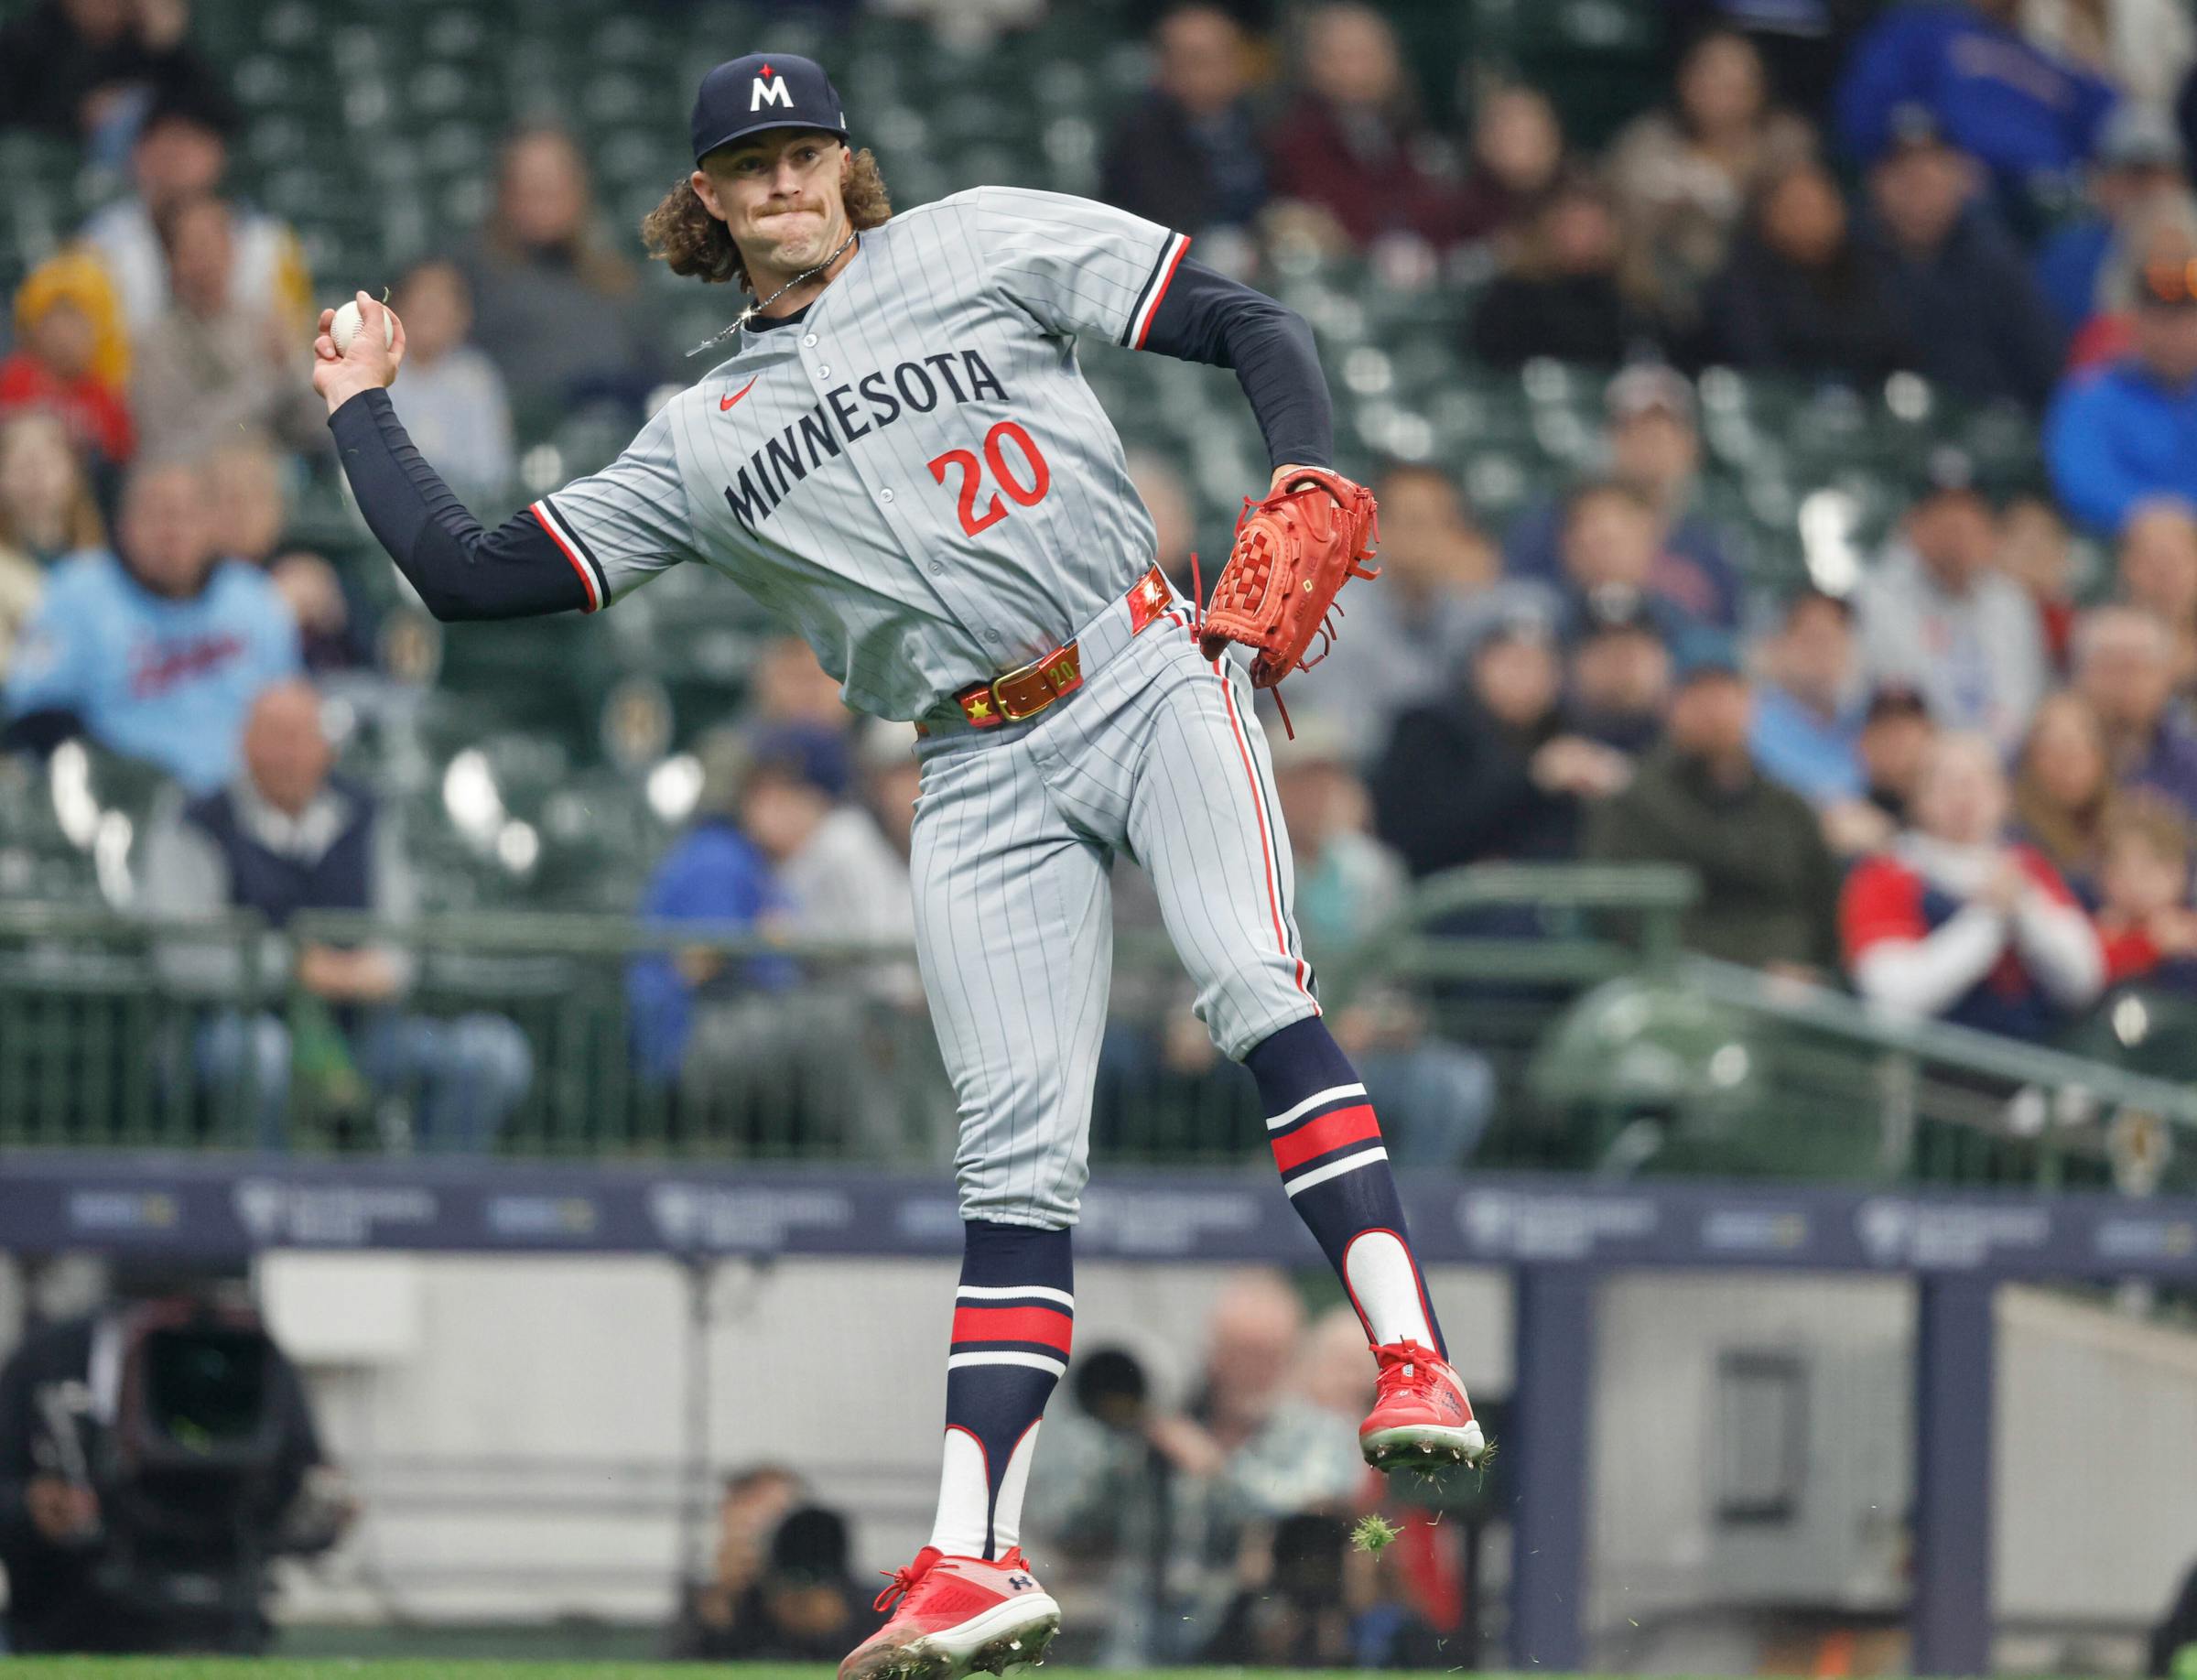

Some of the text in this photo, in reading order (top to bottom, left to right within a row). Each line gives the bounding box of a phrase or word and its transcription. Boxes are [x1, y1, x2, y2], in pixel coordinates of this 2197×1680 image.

[750, 76, 795, 112] M
[723, 349, 1010, 540] MINNESOTA
[927, 420, 1050, 538] 20
[1049, 660, 1077, 688] 20
